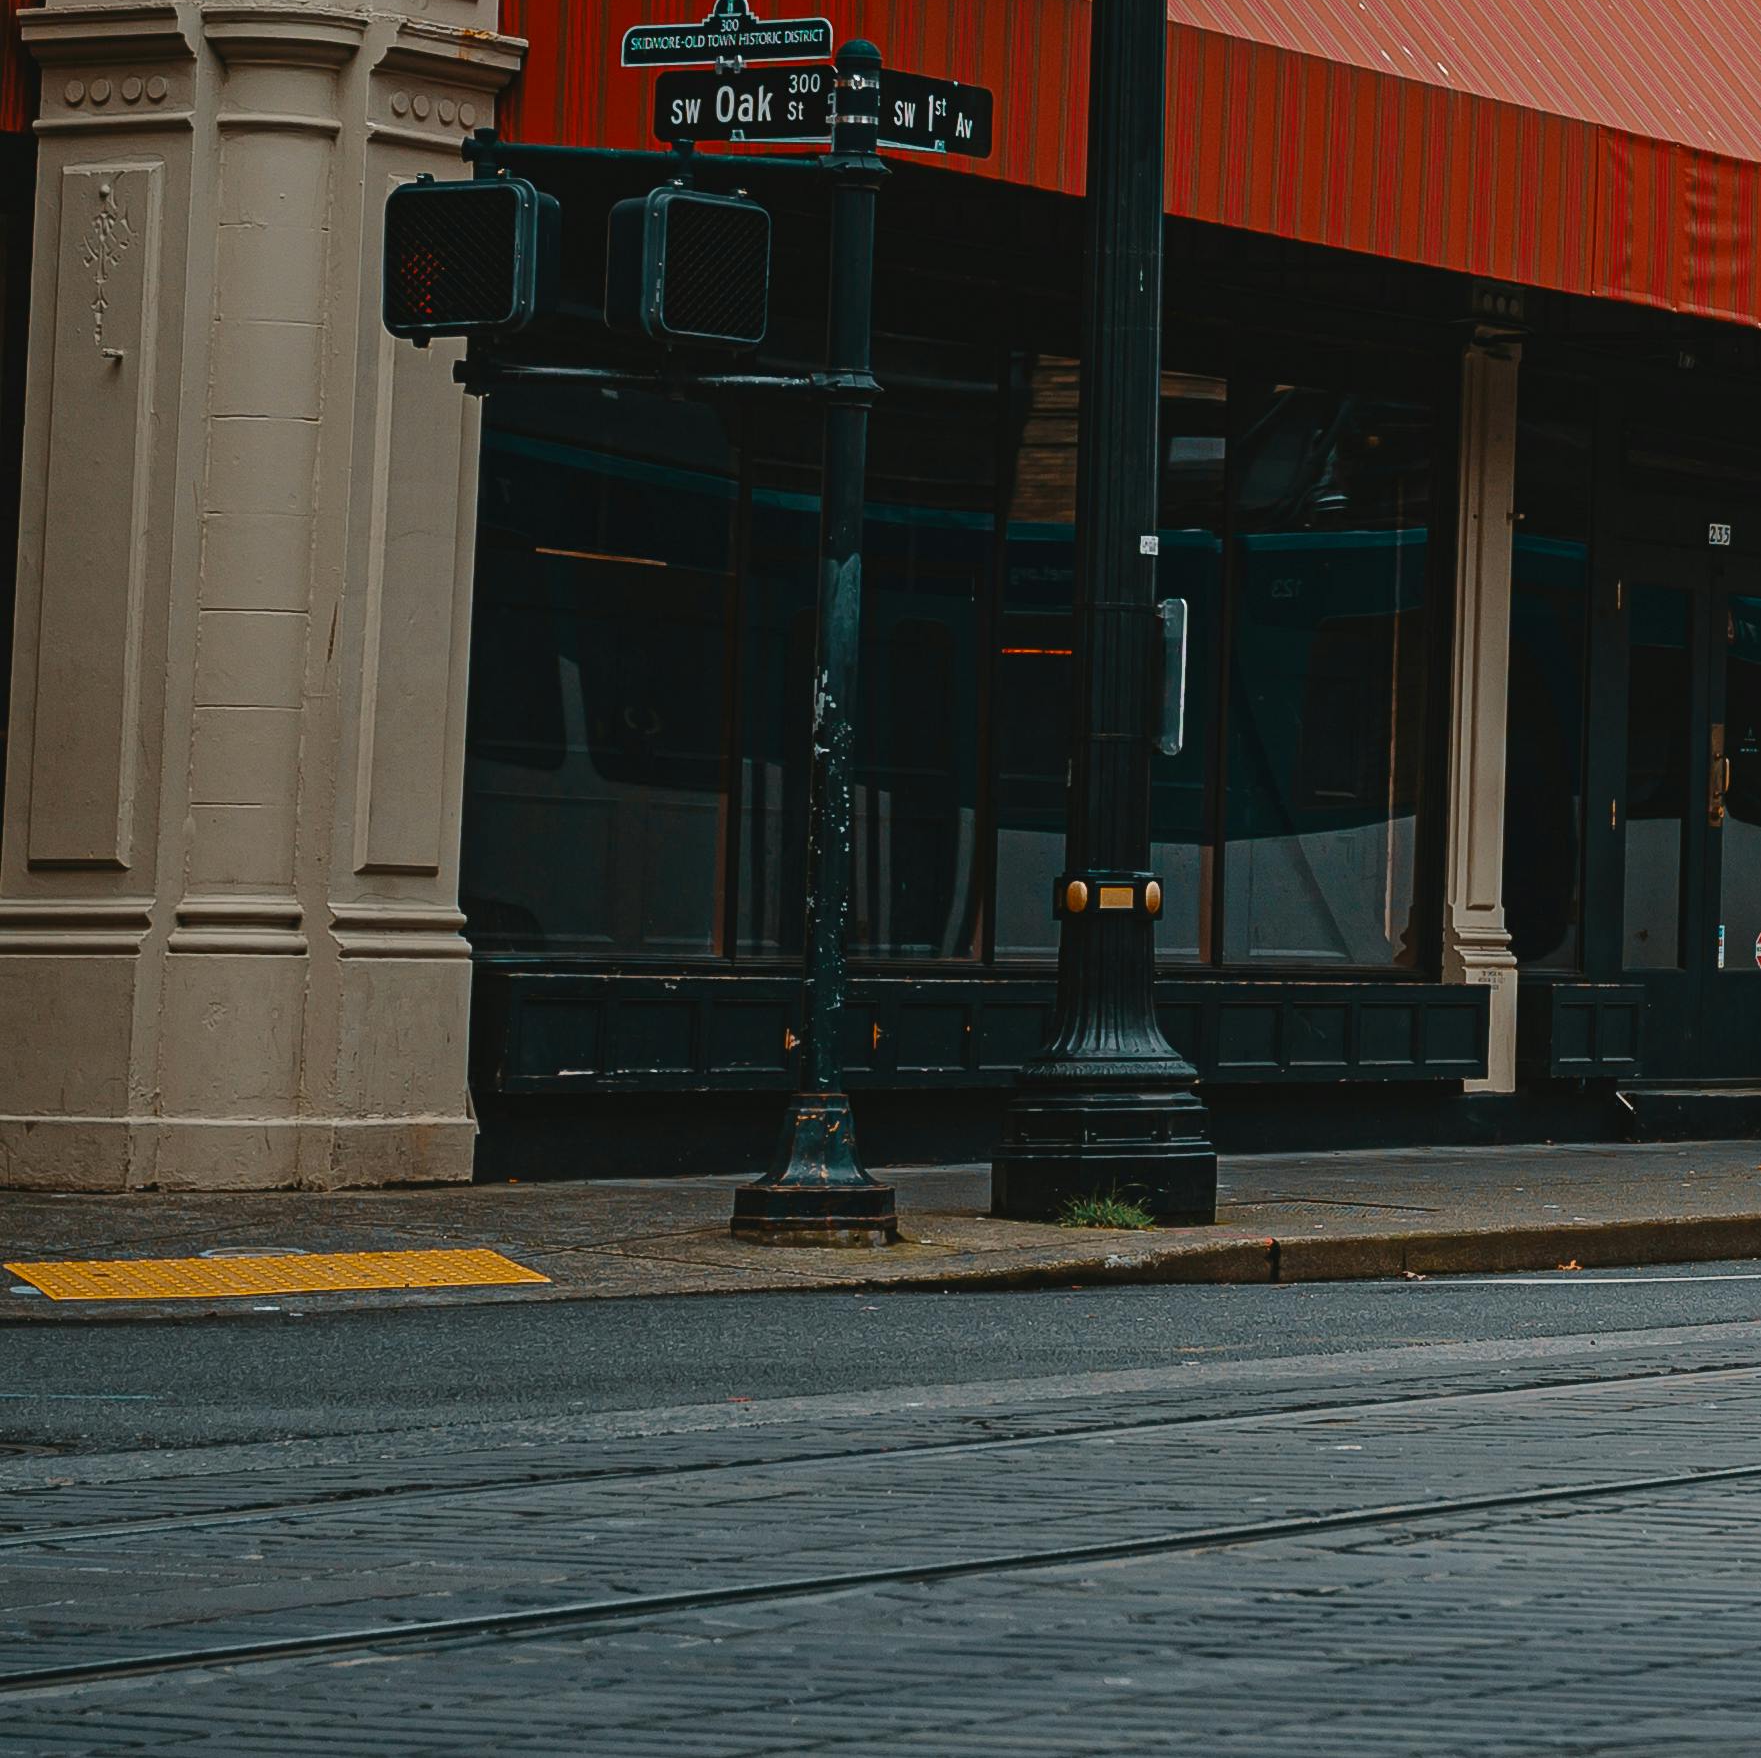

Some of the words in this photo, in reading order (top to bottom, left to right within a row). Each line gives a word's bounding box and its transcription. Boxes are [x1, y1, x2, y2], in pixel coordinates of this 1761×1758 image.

[720, 19, 740, 32] 300
[630, 35, 706, 51] SKIDMORE-OLD
[707, 34, 736, 47] TOWN
[739, 31, 782, 45] HISTORIC
[784, 29, 824, 43] DISTRICT
[788, 73, 821, 94] 300
[670, 98, 701, 125] SW
[715, 84, 774, 123] Oak
[786, 100, 805, 121] St
[893, 100, 916, 129] SW
[928, 94, 947, 132] 1st
[955, 111, 973, 139] Av
[1710, 524, 1730, 544] 235
